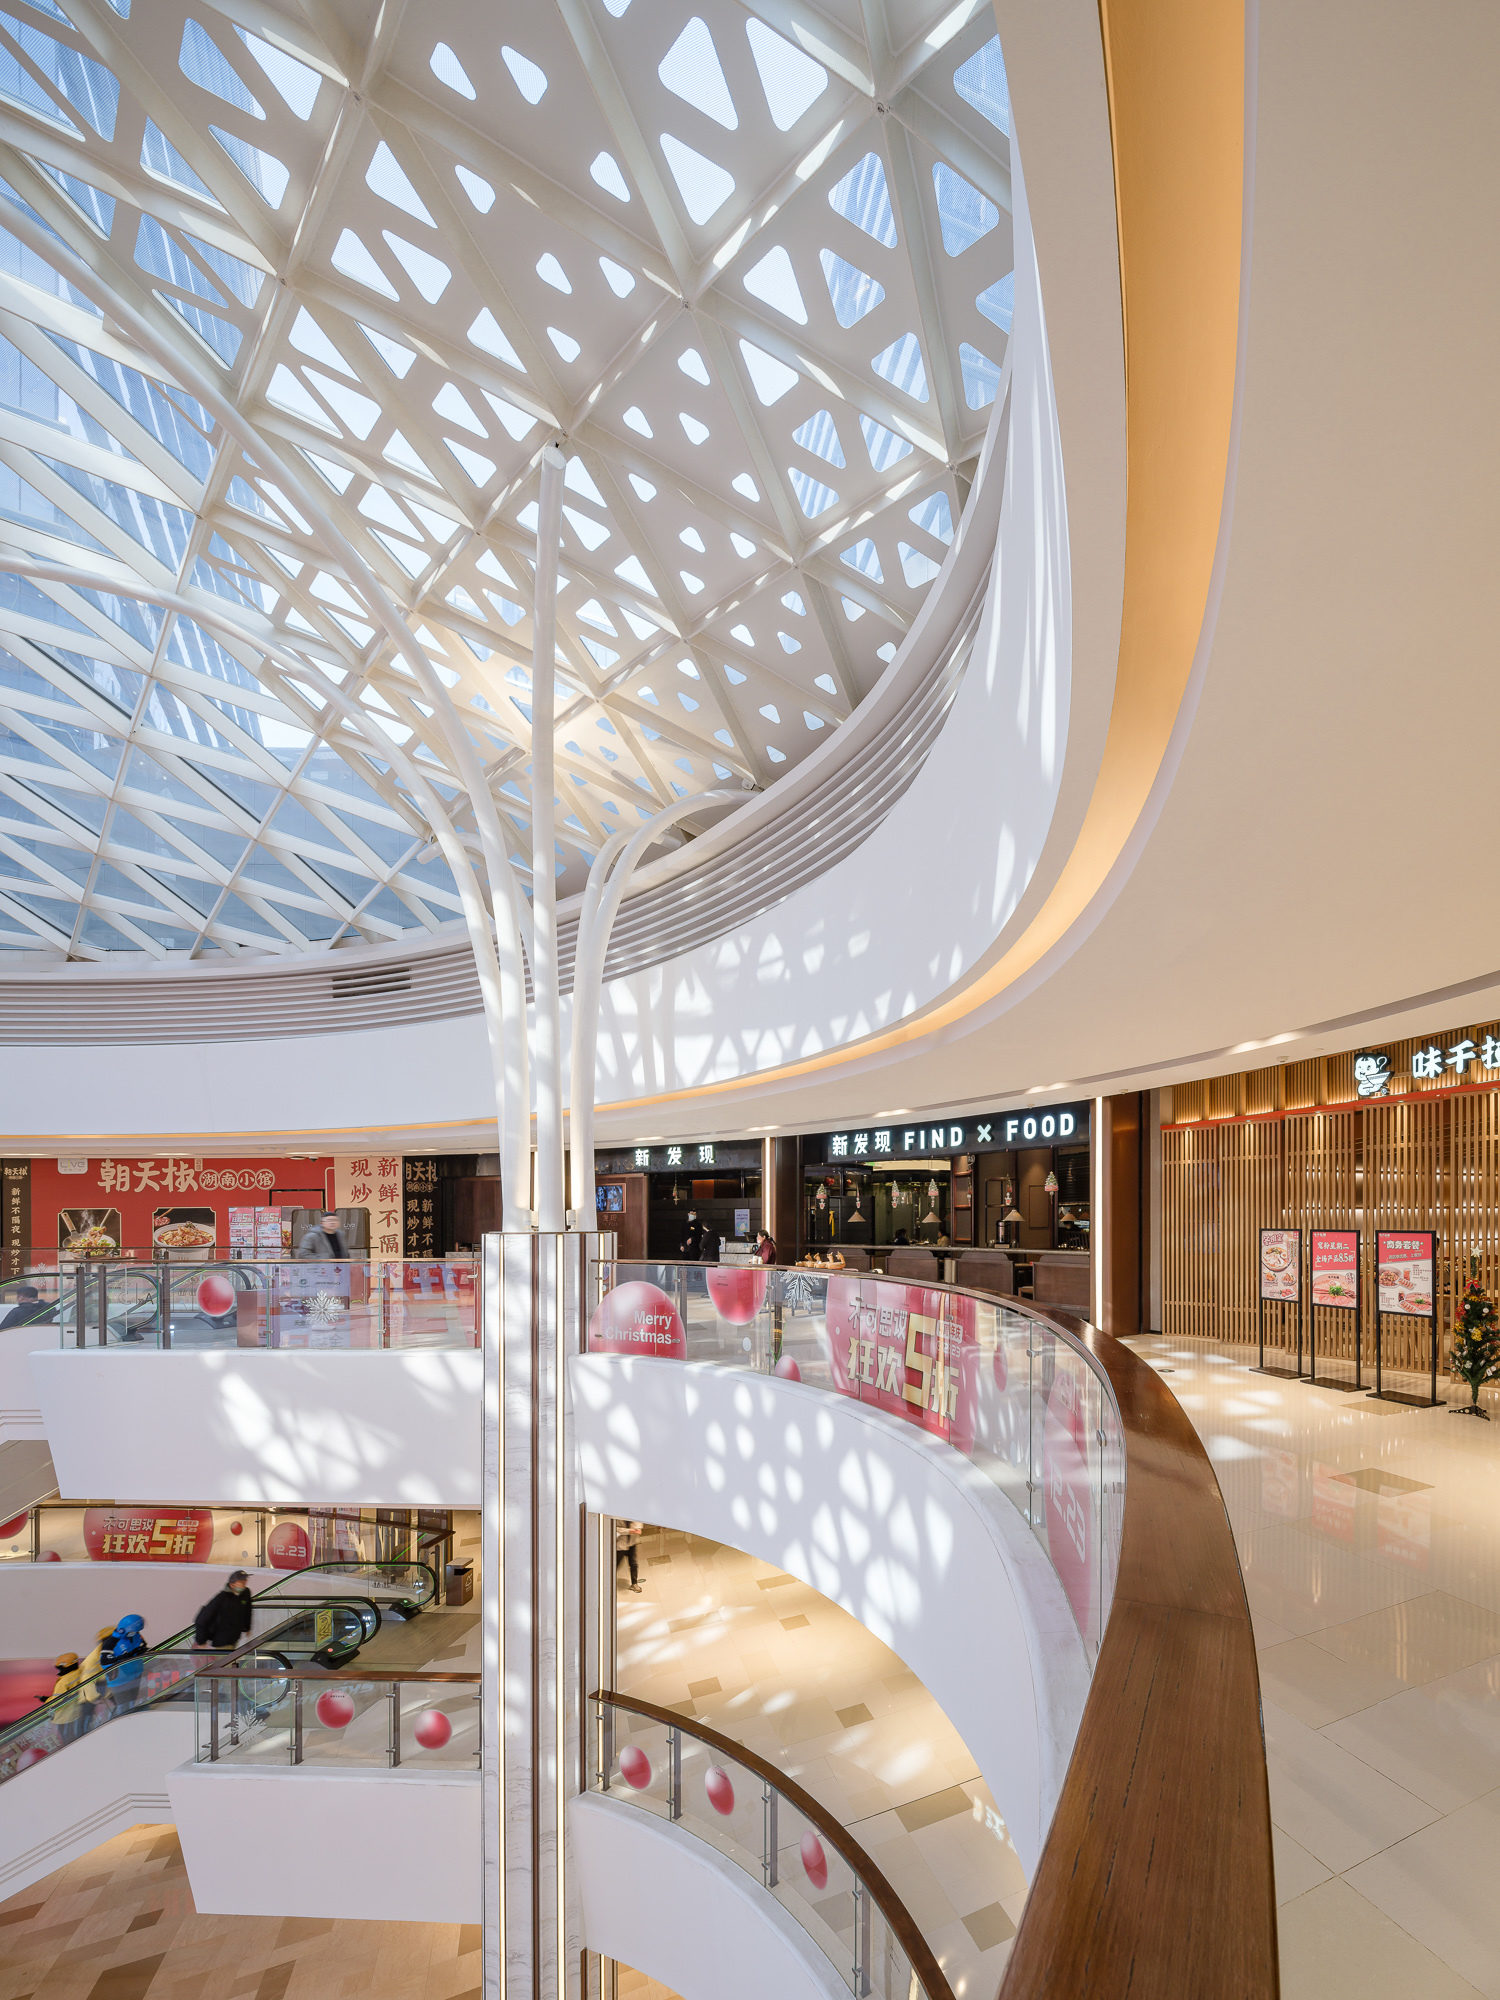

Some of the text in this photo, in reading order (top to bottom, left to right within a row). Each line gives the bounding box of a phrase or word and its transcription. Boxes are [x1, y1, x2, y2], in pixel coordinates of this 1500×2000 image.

[832, 1130, 892, 1156] 新发现
[904, 1126, 964, 1151] FIND
[1006, 1113, 1075, 1142] FOOD
[635, 1145, 715, 1167] 新发现
[200, 1168, 275, 1190] 湖南小馆
[1386, 1239, 1420, 1250] 商务套餐
[11, 1239, 21, 1278] 现炒才下
[633, 1310, 672, 1330] Merry
[848, 1296, 908, 1342] 不可思议
[605, 1326, 672, 1345] Christmas
[847, 1312, 960, 1422] 狂欢5折
[103, 1518, 156, 1531] 不可思议
[102, 1519, 197, 1555] 狂欢5折
[272, 1543, 307, 1557] 12.23
